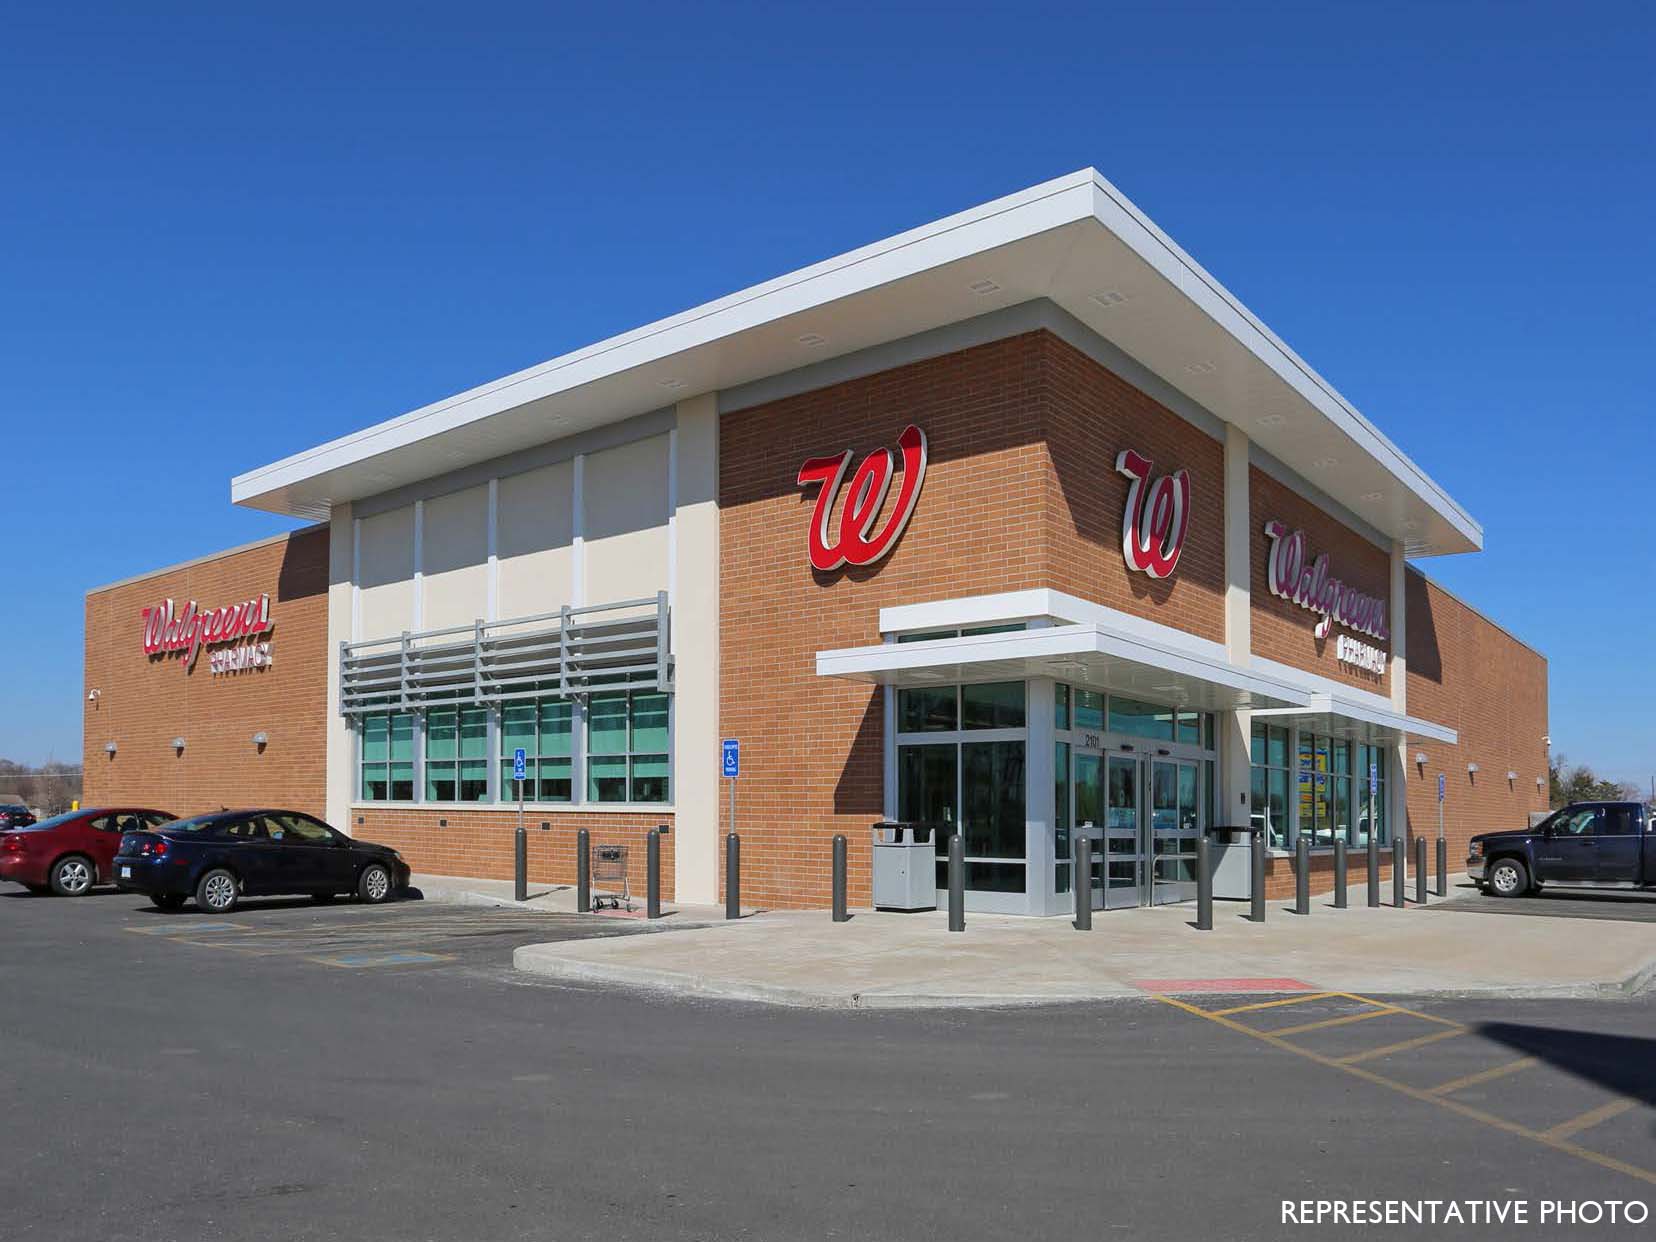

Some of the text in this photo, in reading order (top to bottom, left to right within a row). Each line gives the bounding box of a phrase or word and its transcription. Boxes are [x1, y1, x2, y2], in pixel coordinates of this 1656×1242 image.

[797, 424, 927, 570] W
[1116, 449, 1191, 578] W
[142, 592, 273, 675] Walgreens
[1265, 520, 1389, 640] Walgreens
[1085, 733, 1100, 750] 2101
